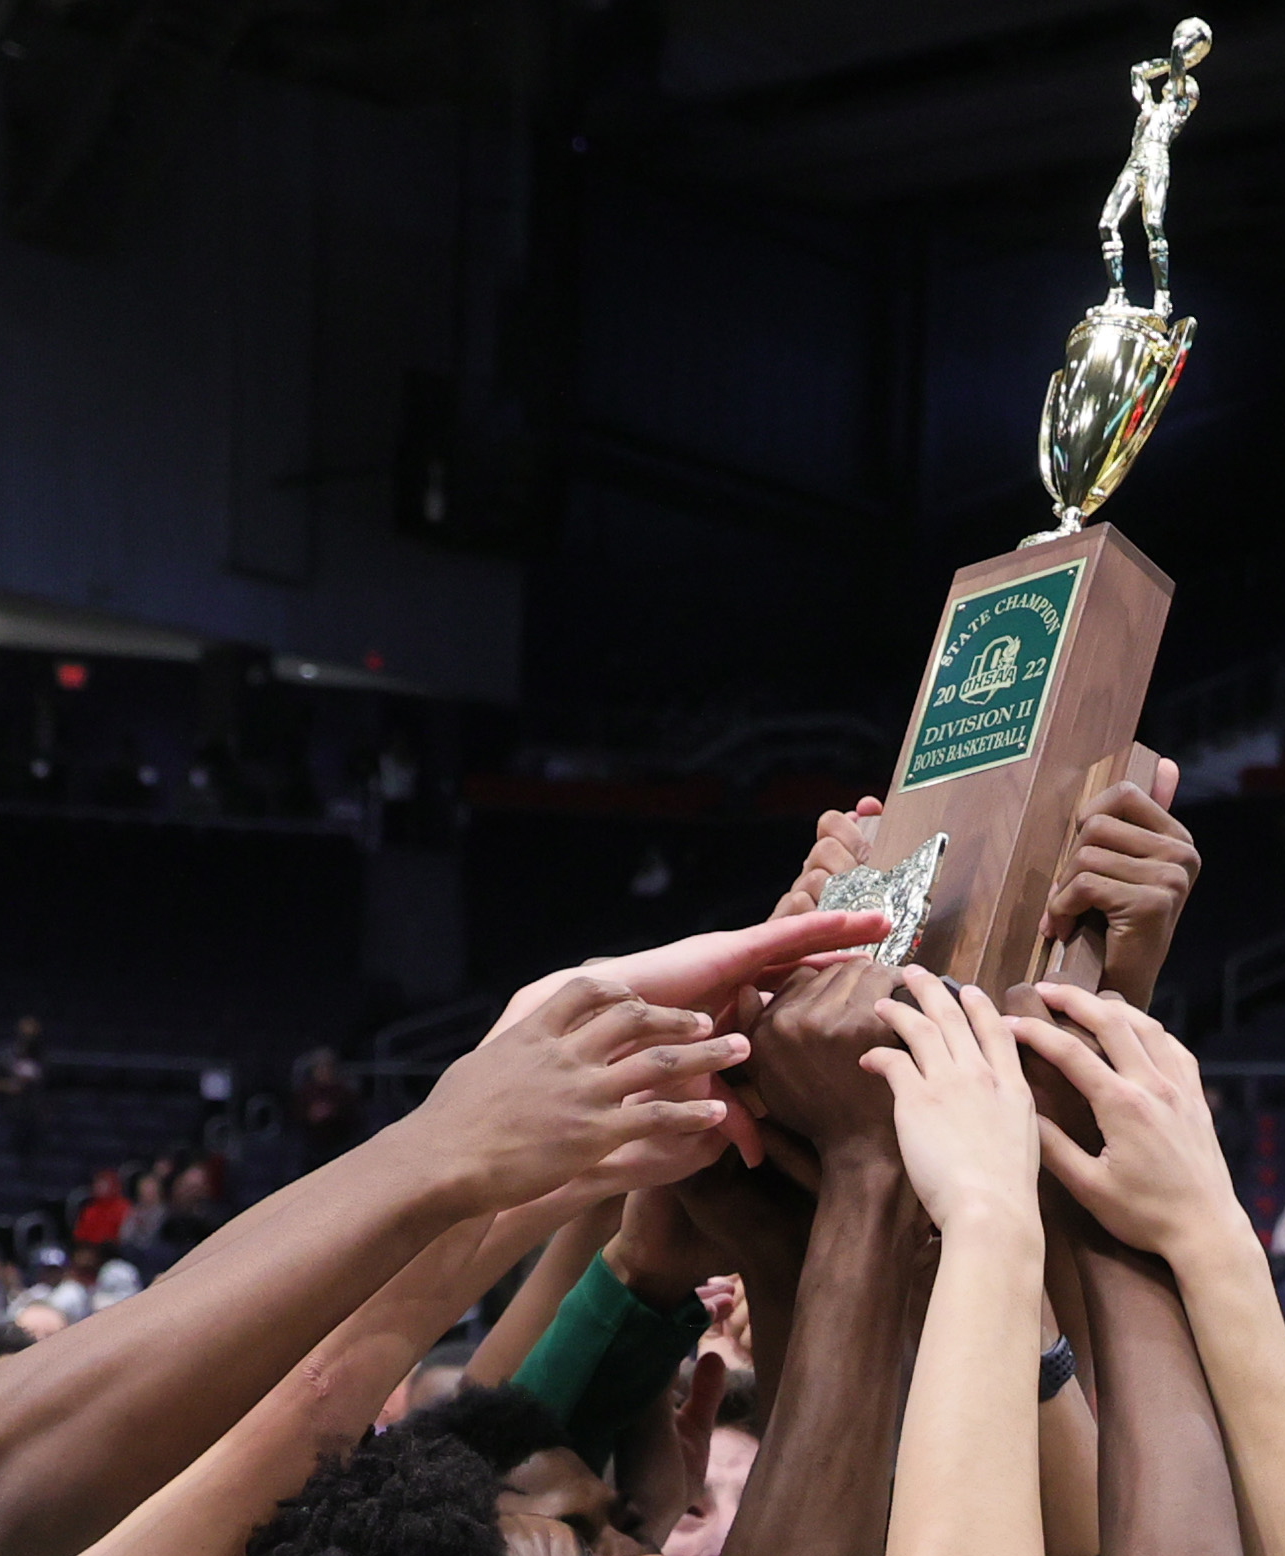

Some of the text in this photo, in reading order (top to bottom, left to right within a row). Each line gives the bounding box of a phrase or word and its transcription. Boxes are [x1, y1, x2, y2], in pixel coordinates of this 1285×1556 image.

[940, 592, 1061, 667] STATE CHAMPION
[962, 667, 1016, 694] OHSAA
[1022, 657, 1047, 681] 22
[932, 684, 956, 707] 20
[922, 698, 1035, 746] DIVISION II
[912, 725, 1026, 773] BOYS BASKETBALL
